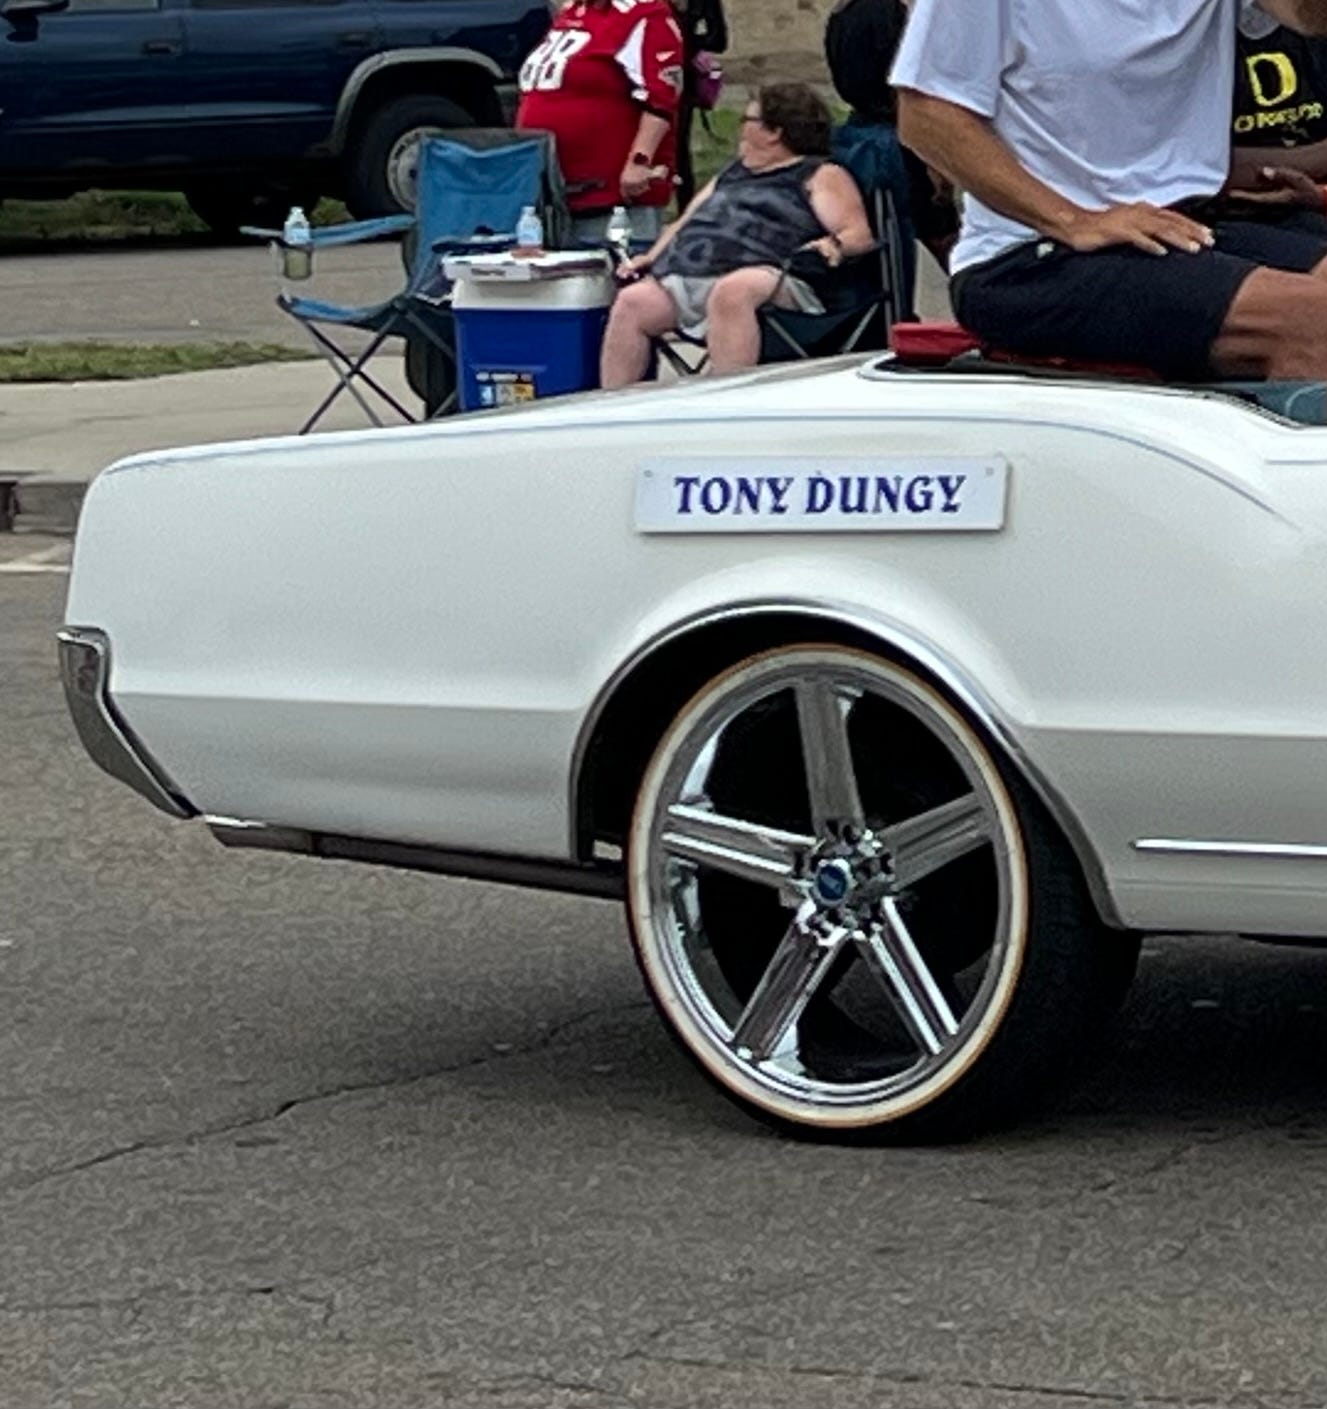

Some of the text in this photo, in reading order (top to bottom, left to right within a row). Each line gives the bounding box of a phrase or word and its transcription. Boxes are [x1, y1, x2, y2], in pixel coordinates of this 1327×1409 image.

[518, 28, 592, 92] 88
[673, 474, 967, 515] TONY DUNGY
